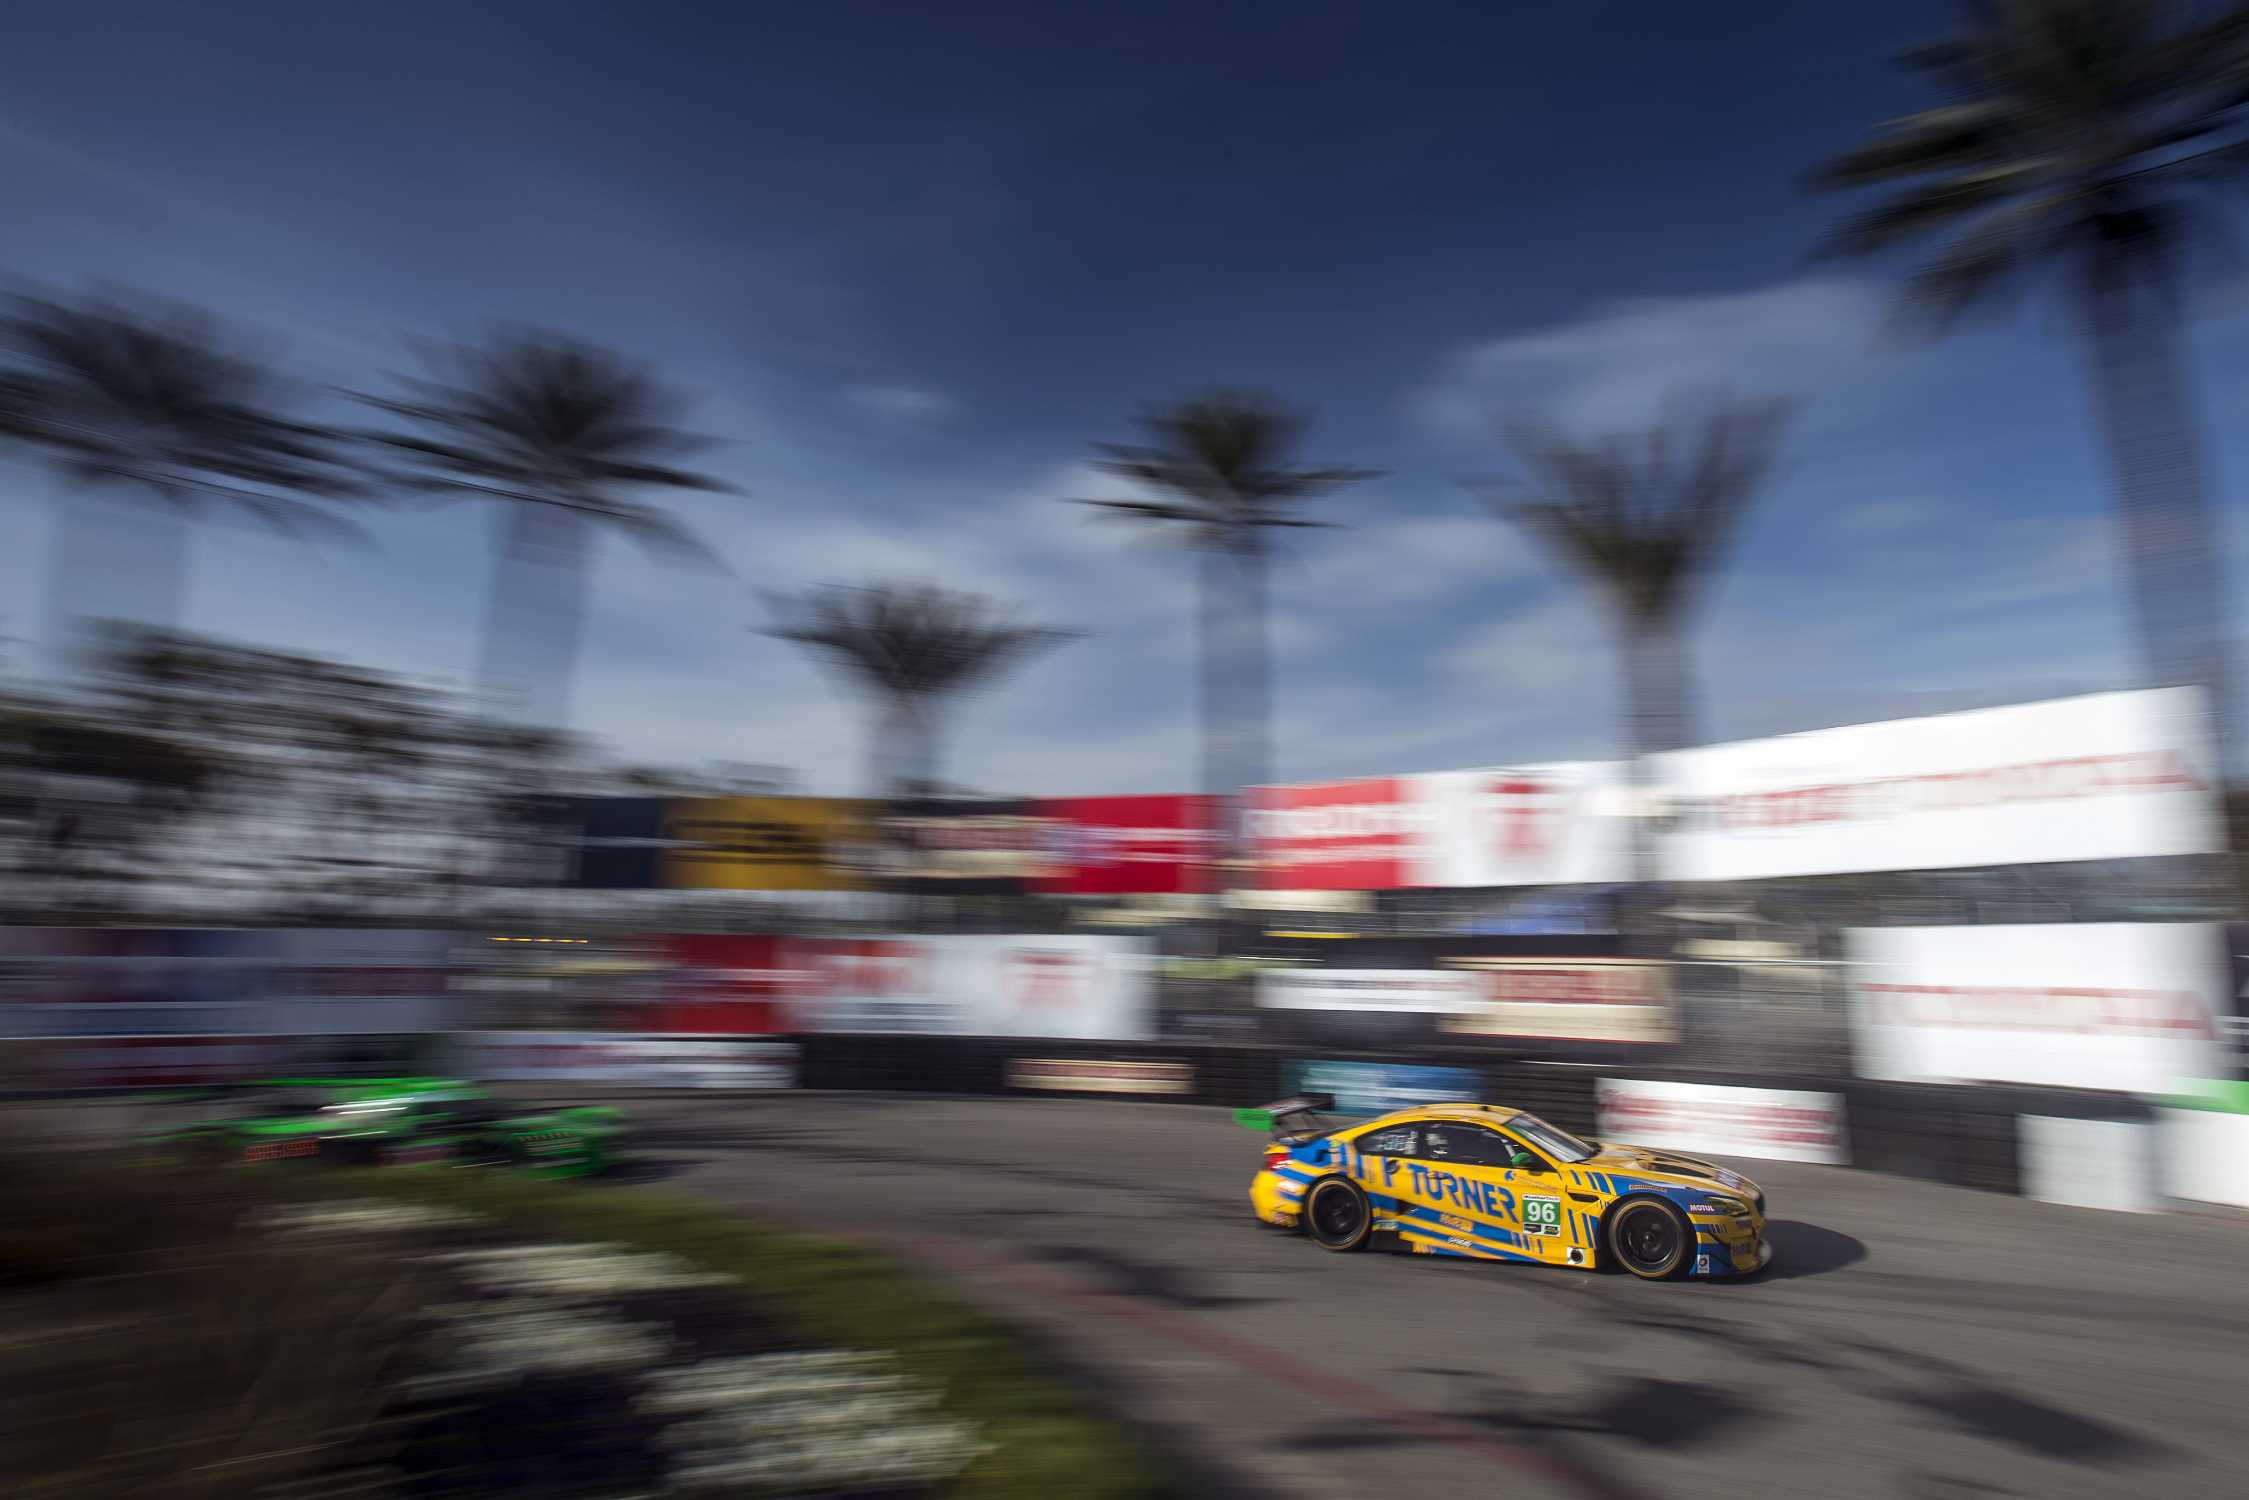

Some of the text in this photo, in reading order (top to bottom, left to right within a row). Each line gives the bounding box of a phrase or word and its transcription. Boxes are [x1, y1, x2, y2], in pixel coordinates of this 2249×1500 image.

[1407, 1163, 1519, 1223] TURNER
[1527, 1201, 1556, 1222] 96
[1689, 1204, 1715, 1212] MOTUL
